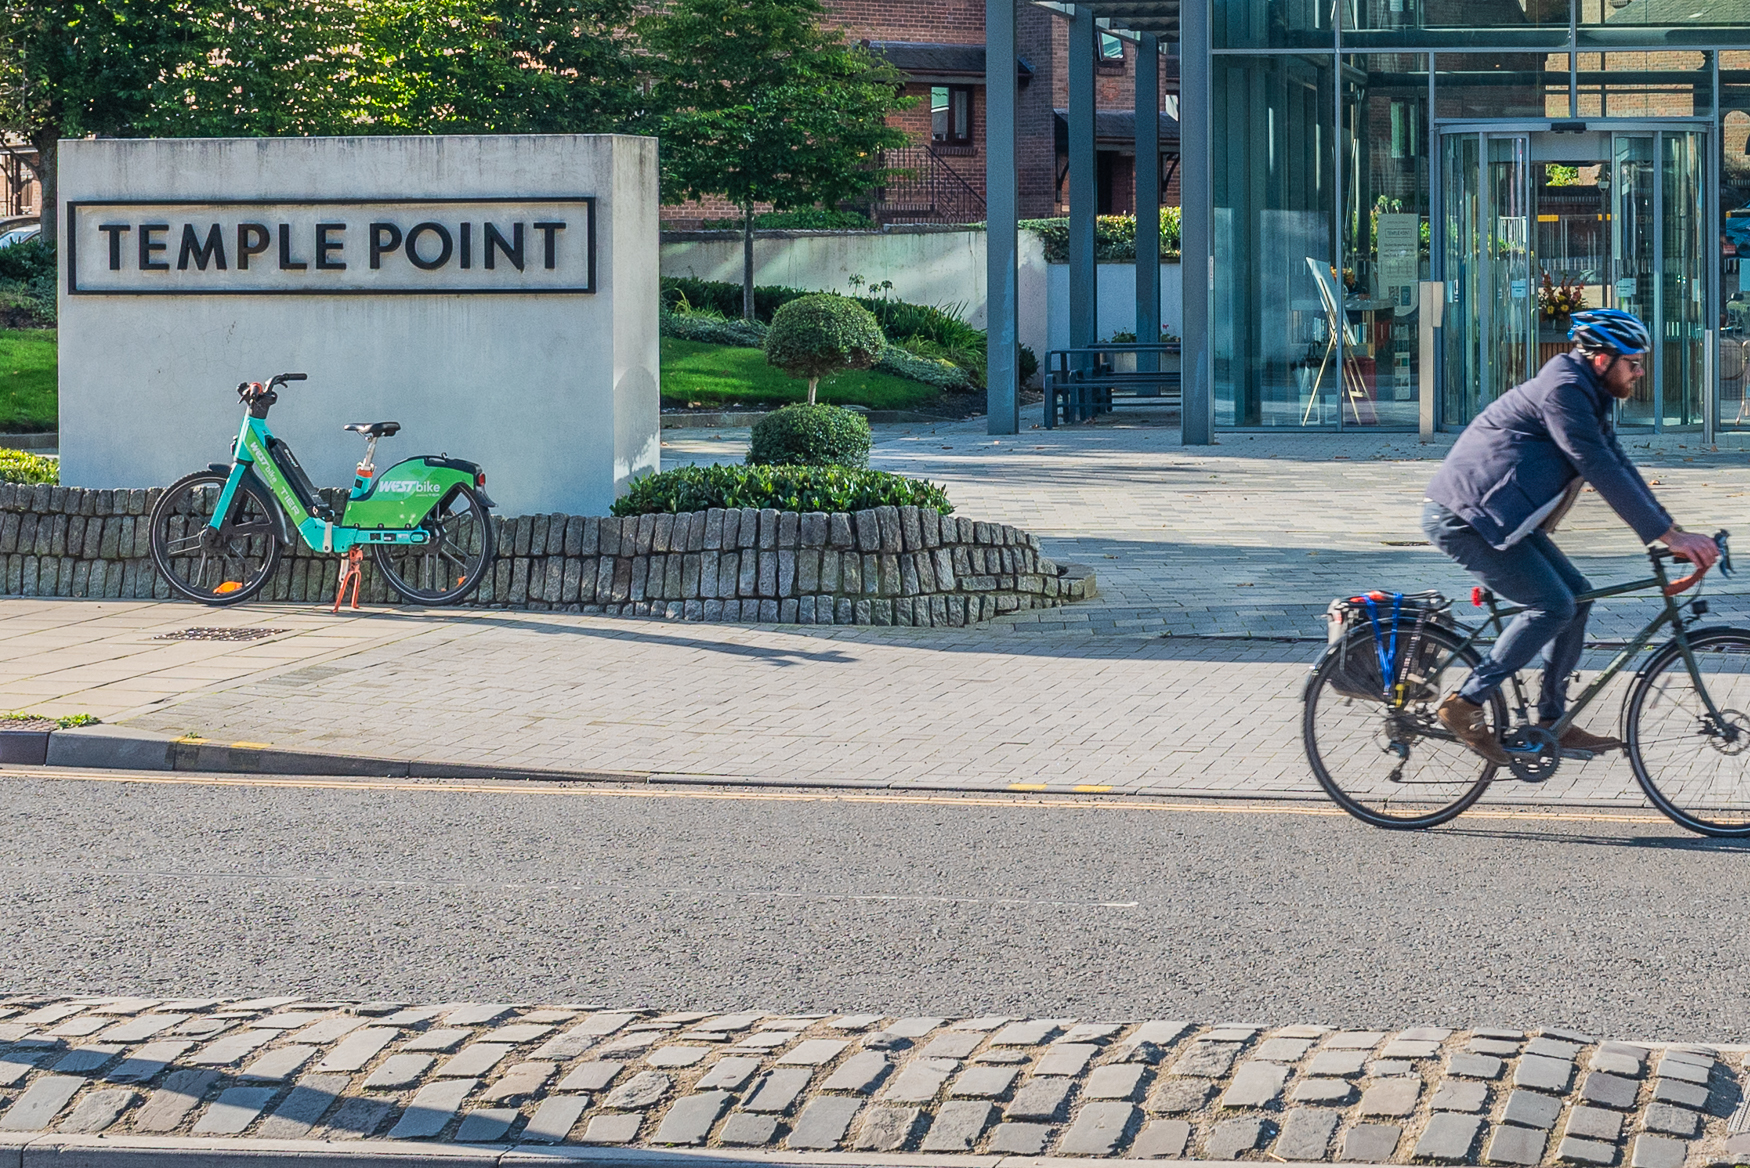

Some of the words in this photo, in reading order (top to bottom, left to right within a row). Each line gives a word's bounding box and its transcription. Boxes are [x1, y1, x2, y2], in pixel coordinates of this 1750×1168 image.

[98, 222, 347, 271] TEMPLE
[369, 221, 567, 272] POINT
[280, 485, 300, 516] TIER
